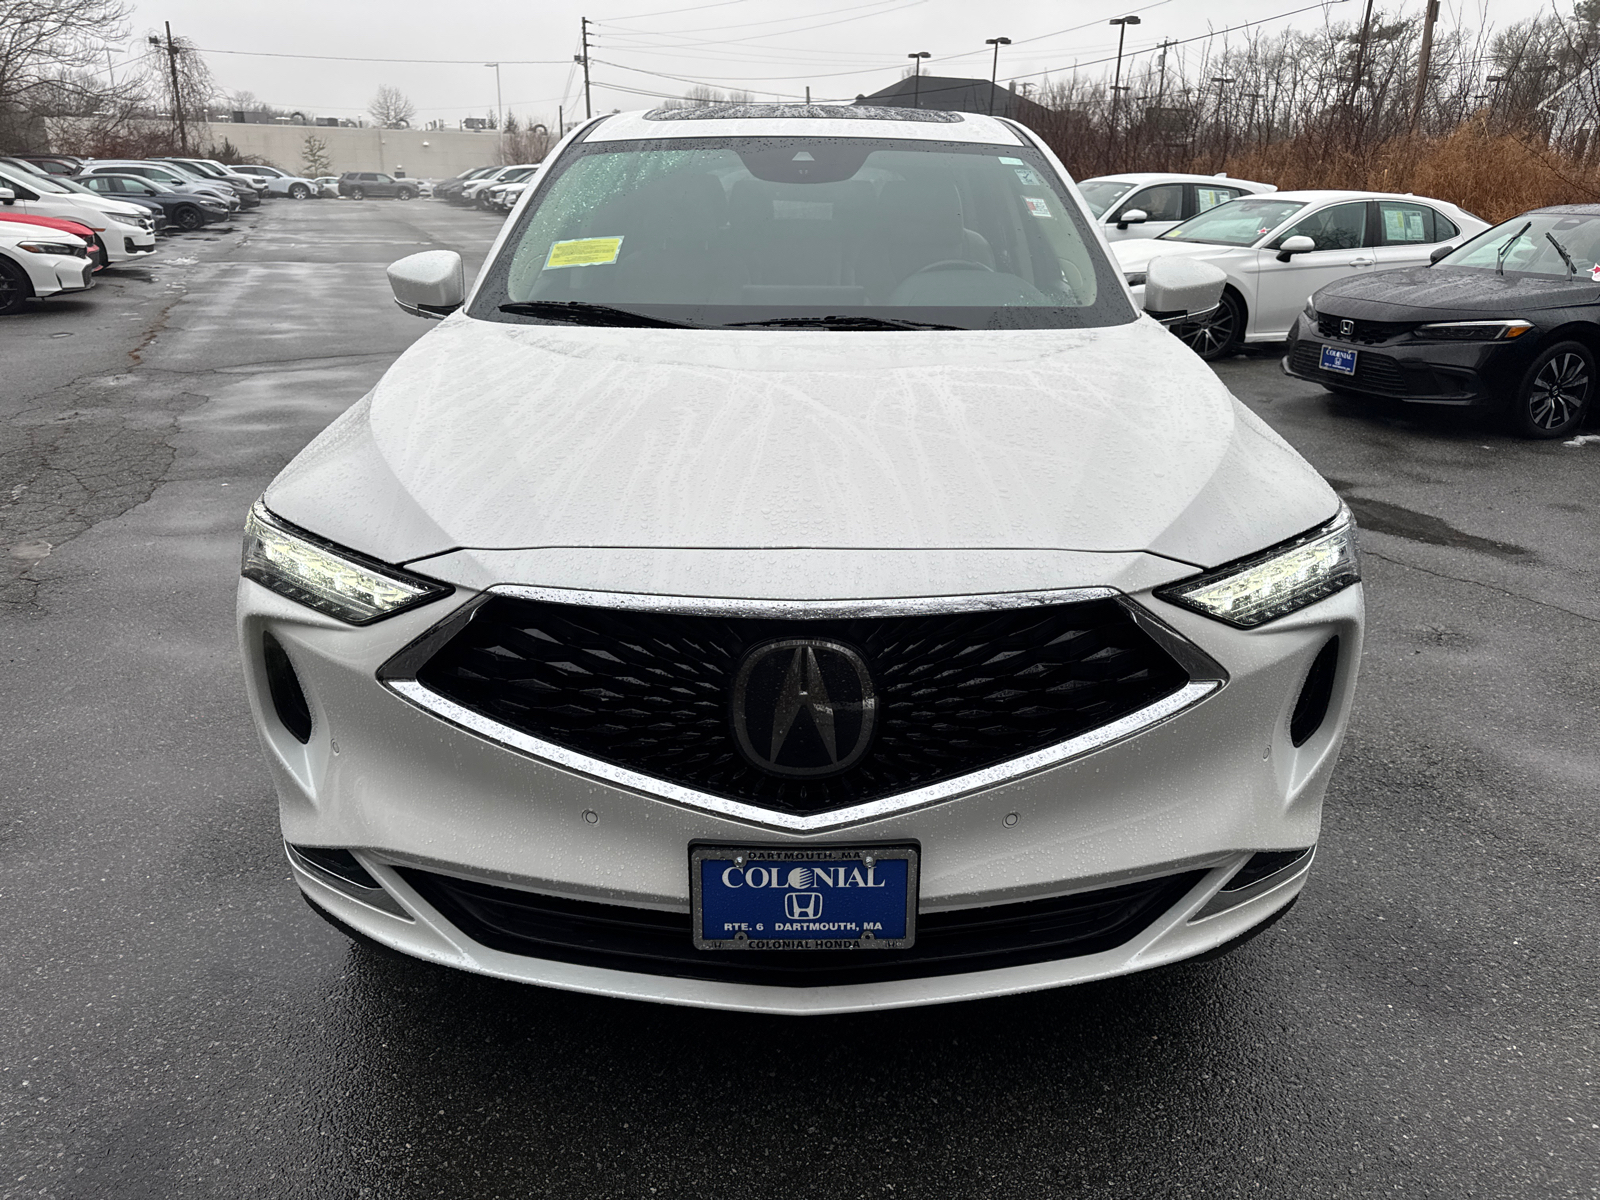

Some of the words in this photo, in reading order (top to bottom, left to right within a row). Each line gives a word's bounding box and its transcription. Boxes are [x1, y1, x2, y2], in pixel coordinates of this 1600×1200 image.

[1326, 349, 1353, 360] COLONIAL
[841, 851, 861, 859] MA
[721, 866, 886, 889] COLONIAL
[724, 922, 753, 931] RTE.
[755, 922, 764, 931] 6
[774, 922, 859, 931] DARTMOUTH,
[863, 921, 883, 930] MA
[749, 940, 811, 949] COLONIAL
[815, 940, 860, 949] HONDA
